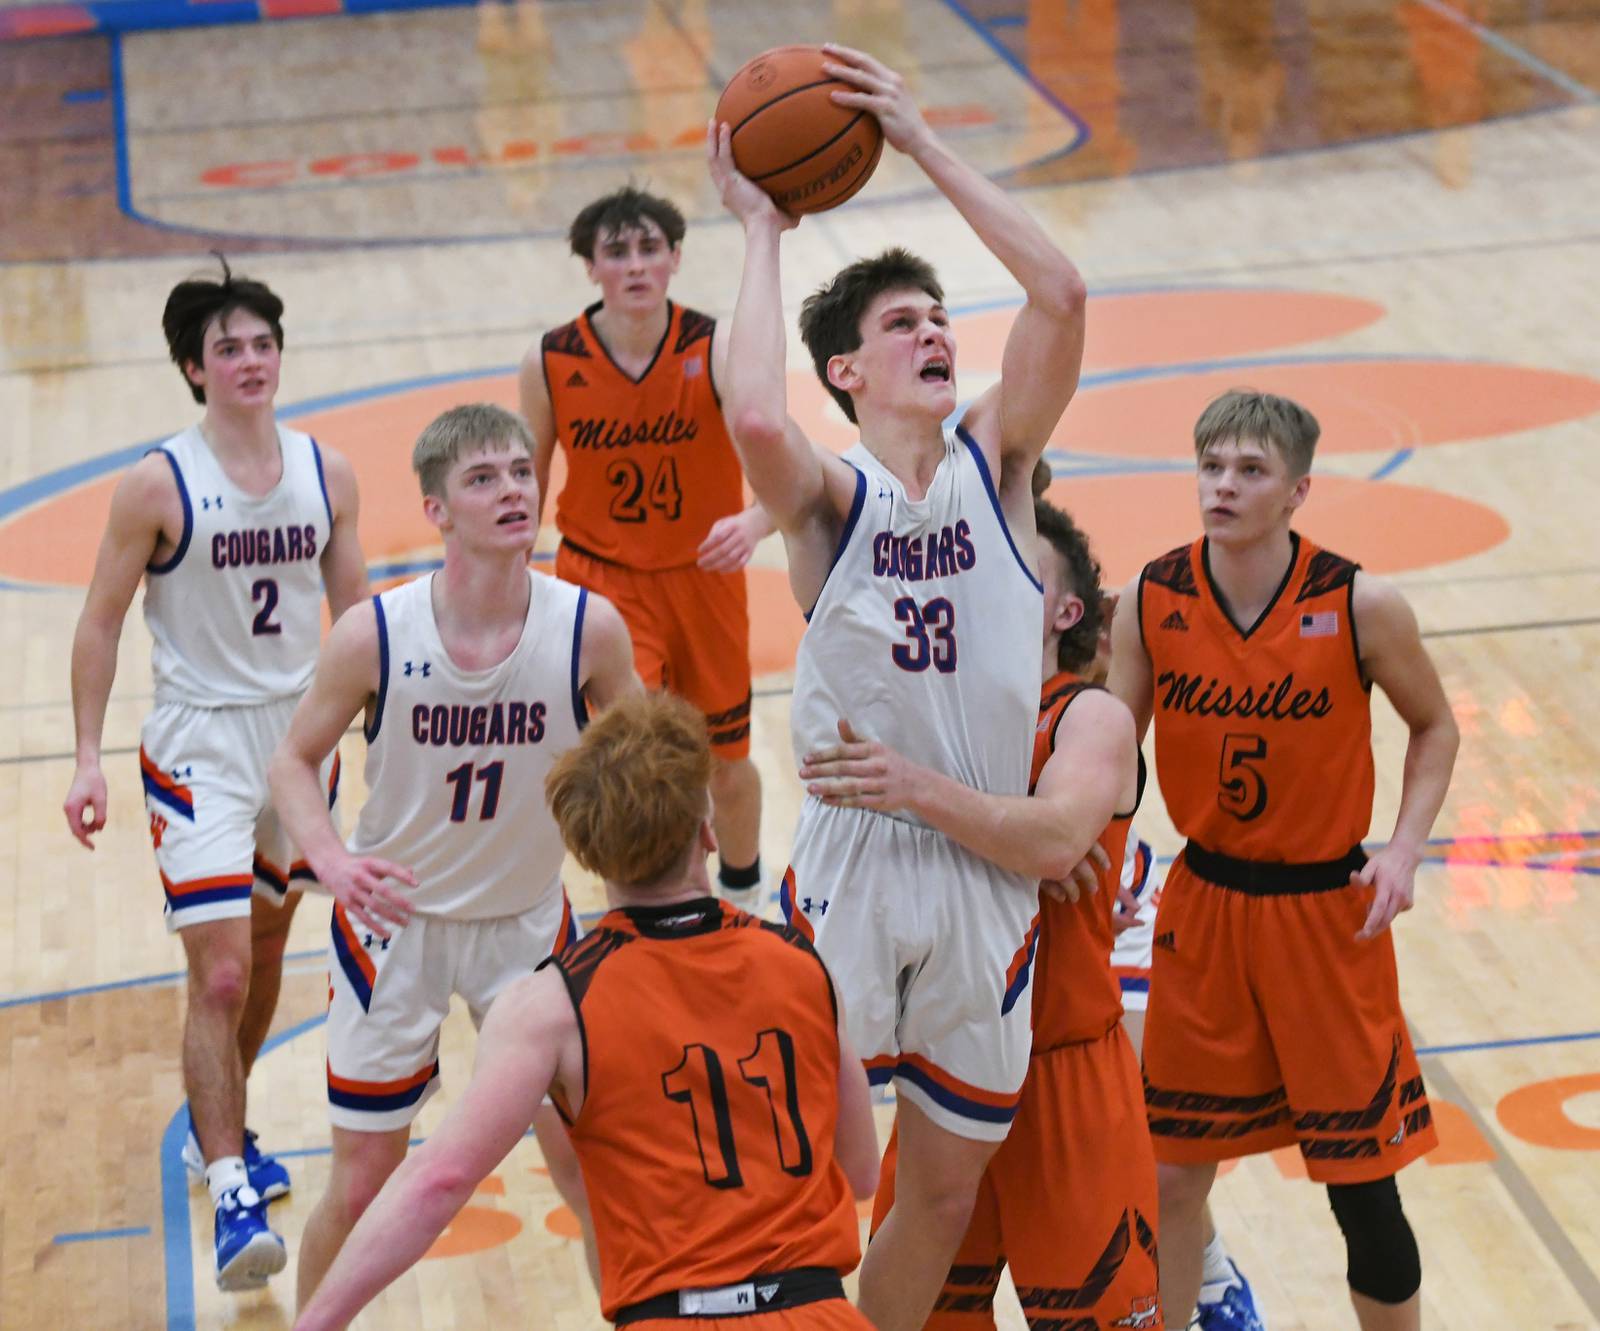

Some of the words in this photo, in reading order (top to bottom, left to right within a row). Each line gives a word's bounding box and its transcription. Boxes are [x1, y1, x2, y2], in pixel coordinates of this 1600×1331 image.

[570, 410, 698, 450] Missiles
[606, 455, 682, 523] 24
[211, 524, 317, 570] COUGARS
[251, 578, 282, 636] 2
[891, 597, 958, 673] 33
[412, 701, 547, 746] COUGARS
[1158, 669, 1333, 720] Missiles
[446, 760, 505, 822] 11
[1217, 733, 1268, 822] 5
[661, 1028, 813, 1190] 11
